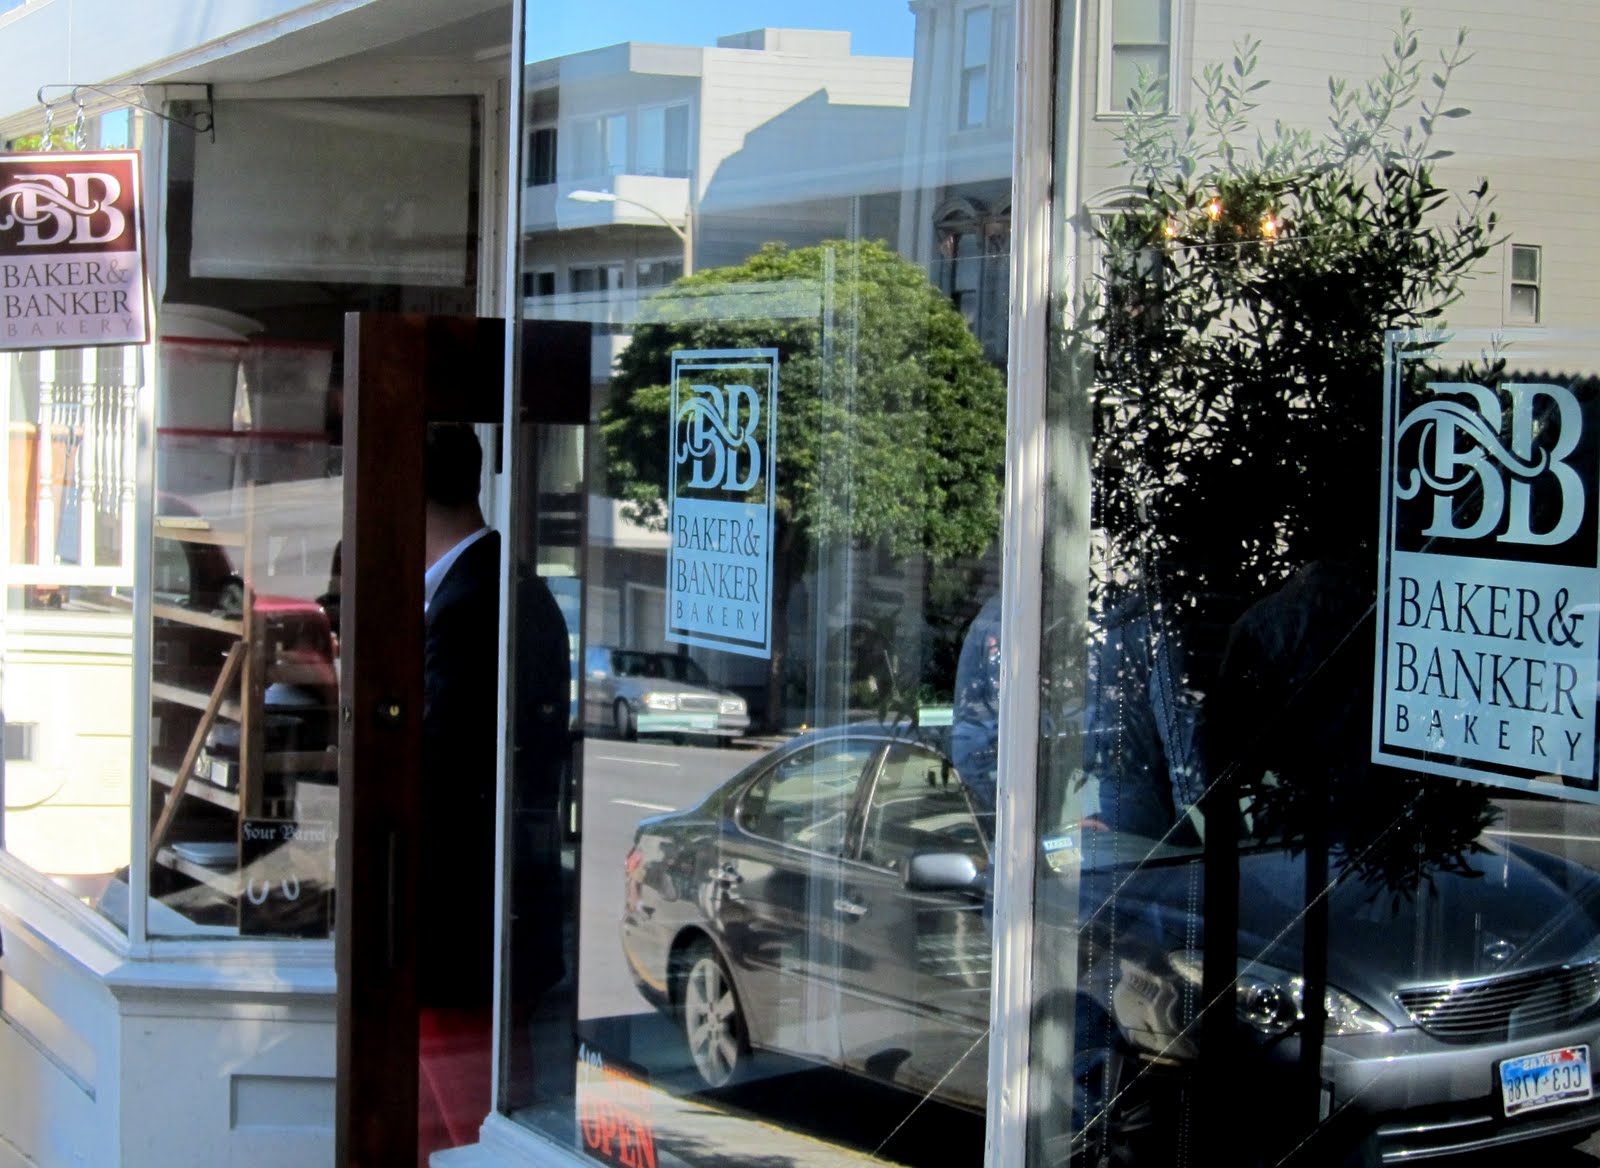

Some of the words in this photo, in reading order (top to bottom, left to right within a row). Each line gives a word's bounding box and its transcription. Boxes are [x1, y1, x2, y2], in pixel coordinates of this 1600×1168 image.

[6, 289, 131, 318] BANKER
[8, 318, 134, 337] BAKERY
[676, 558, 760, 604] BANKER
[676, 605, 760, 632] BAKERY
[1395, 642, 1584, 719] BANKER
[1395, 704, 1582, 762] BAKERY
[581, 1096, 656, 1168] OPEN
